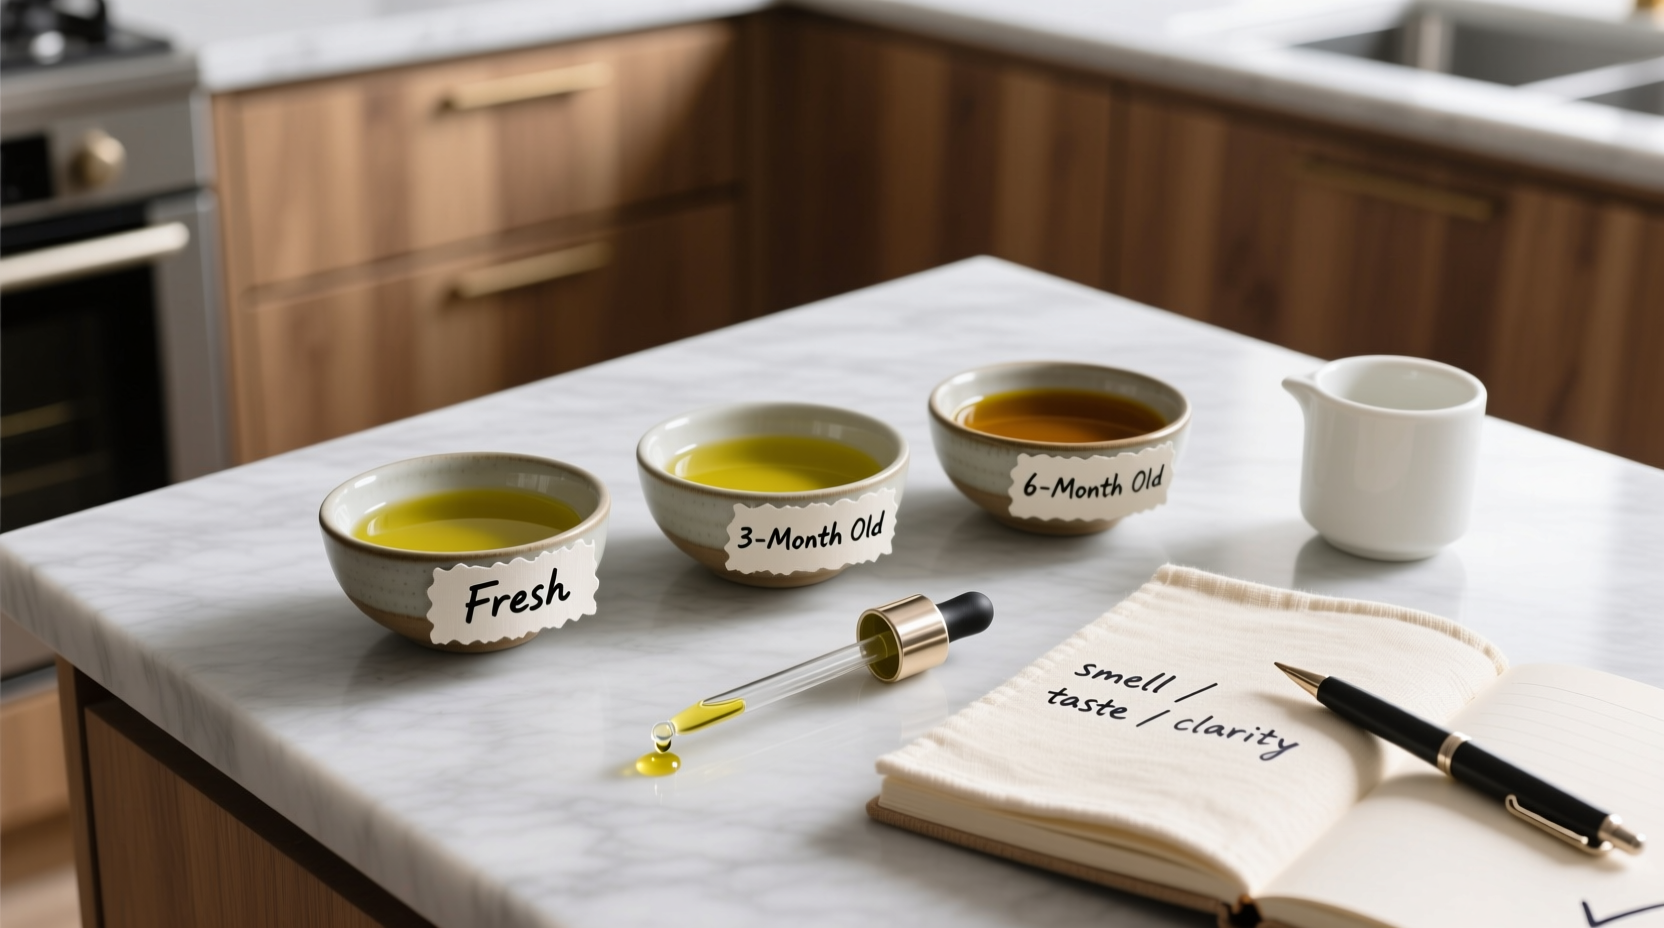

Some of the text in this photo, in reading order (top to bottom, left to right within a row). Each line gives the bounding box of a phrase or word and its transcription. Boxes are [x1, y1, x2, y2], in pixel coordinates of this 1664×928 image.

[1023, 463, 1165, 500] 6-Month Old
[737, 509, 886, 552] 3-Month Old
[465, 568, 571, 624] Fresh
[1074, 662, 1177, 694] smell
[1047, 687, 1128, 721] taste
[1173, 715, 1299, 761] clarity
